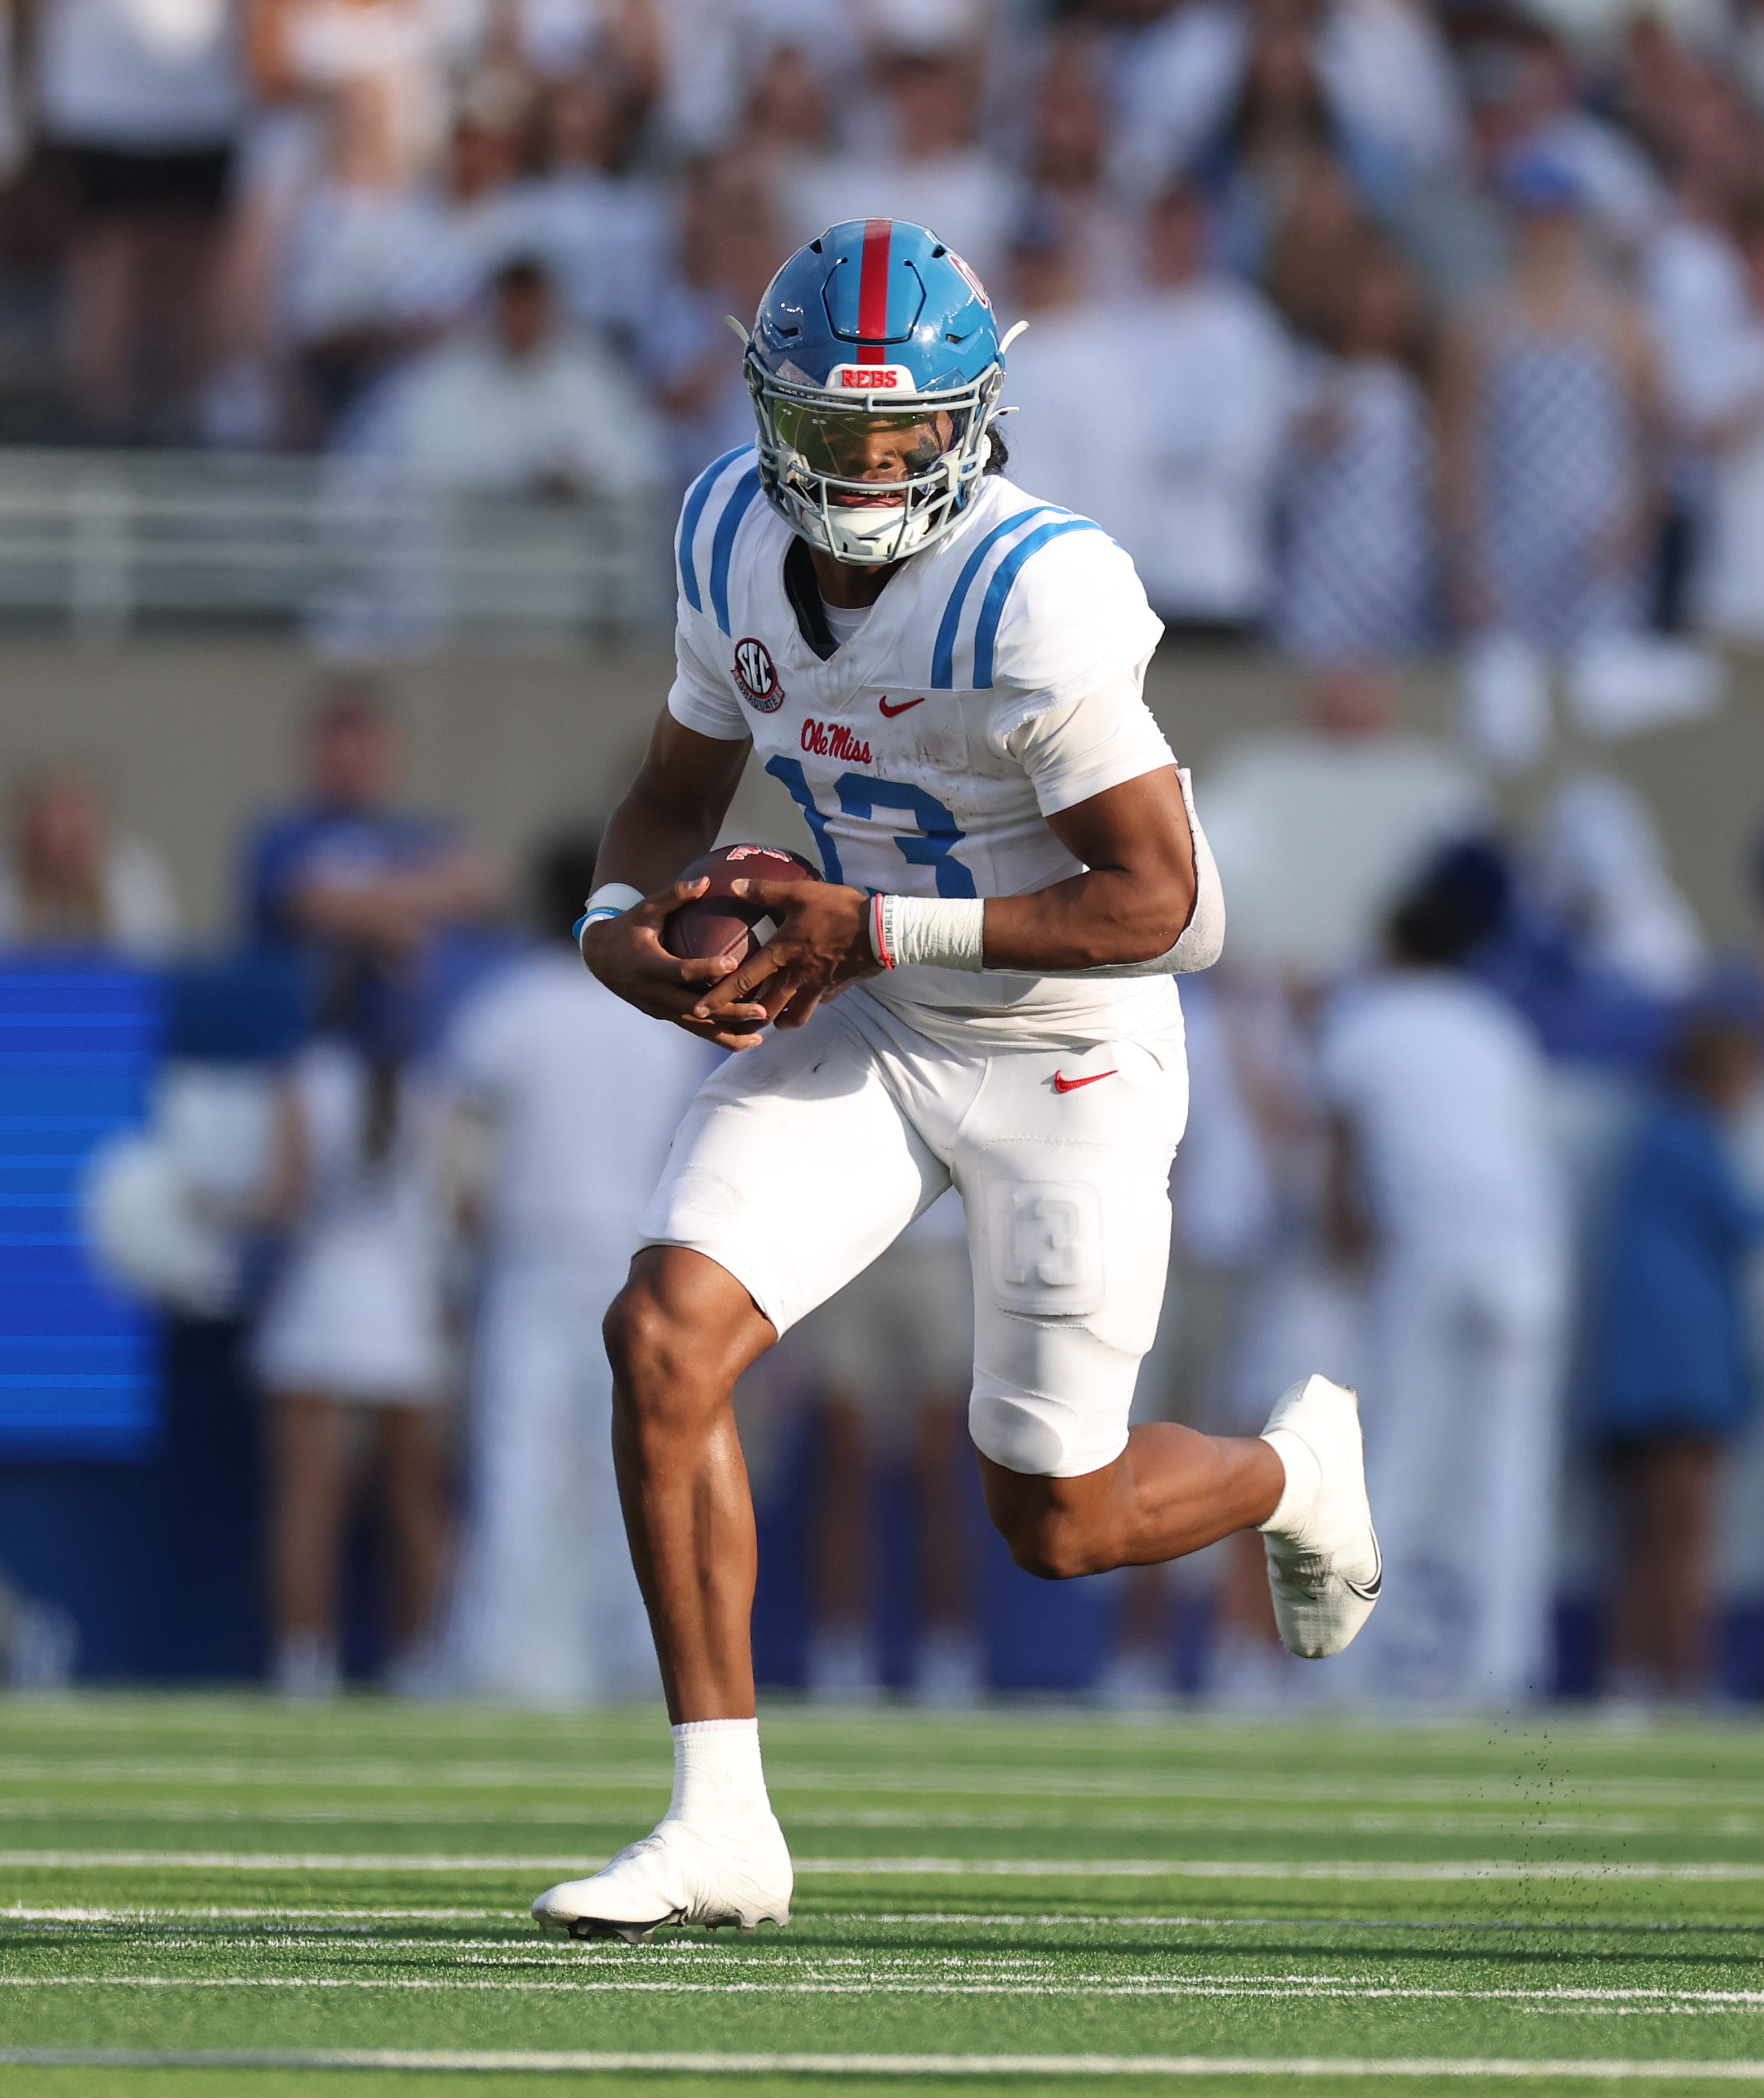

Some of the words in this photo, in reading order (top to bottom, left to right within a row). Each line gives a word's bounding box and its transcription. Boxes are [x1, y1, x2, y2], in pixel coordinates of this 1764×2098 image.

[842, 369, 897, 387] REBS
[738, 642, 772, 694] SEC
[801, 718, 828, 755] Ole
[827, 723, 873, 764] Miss
[765, 754, 978, 899] 13
[885, 908, 894, 947] HUMBLE
